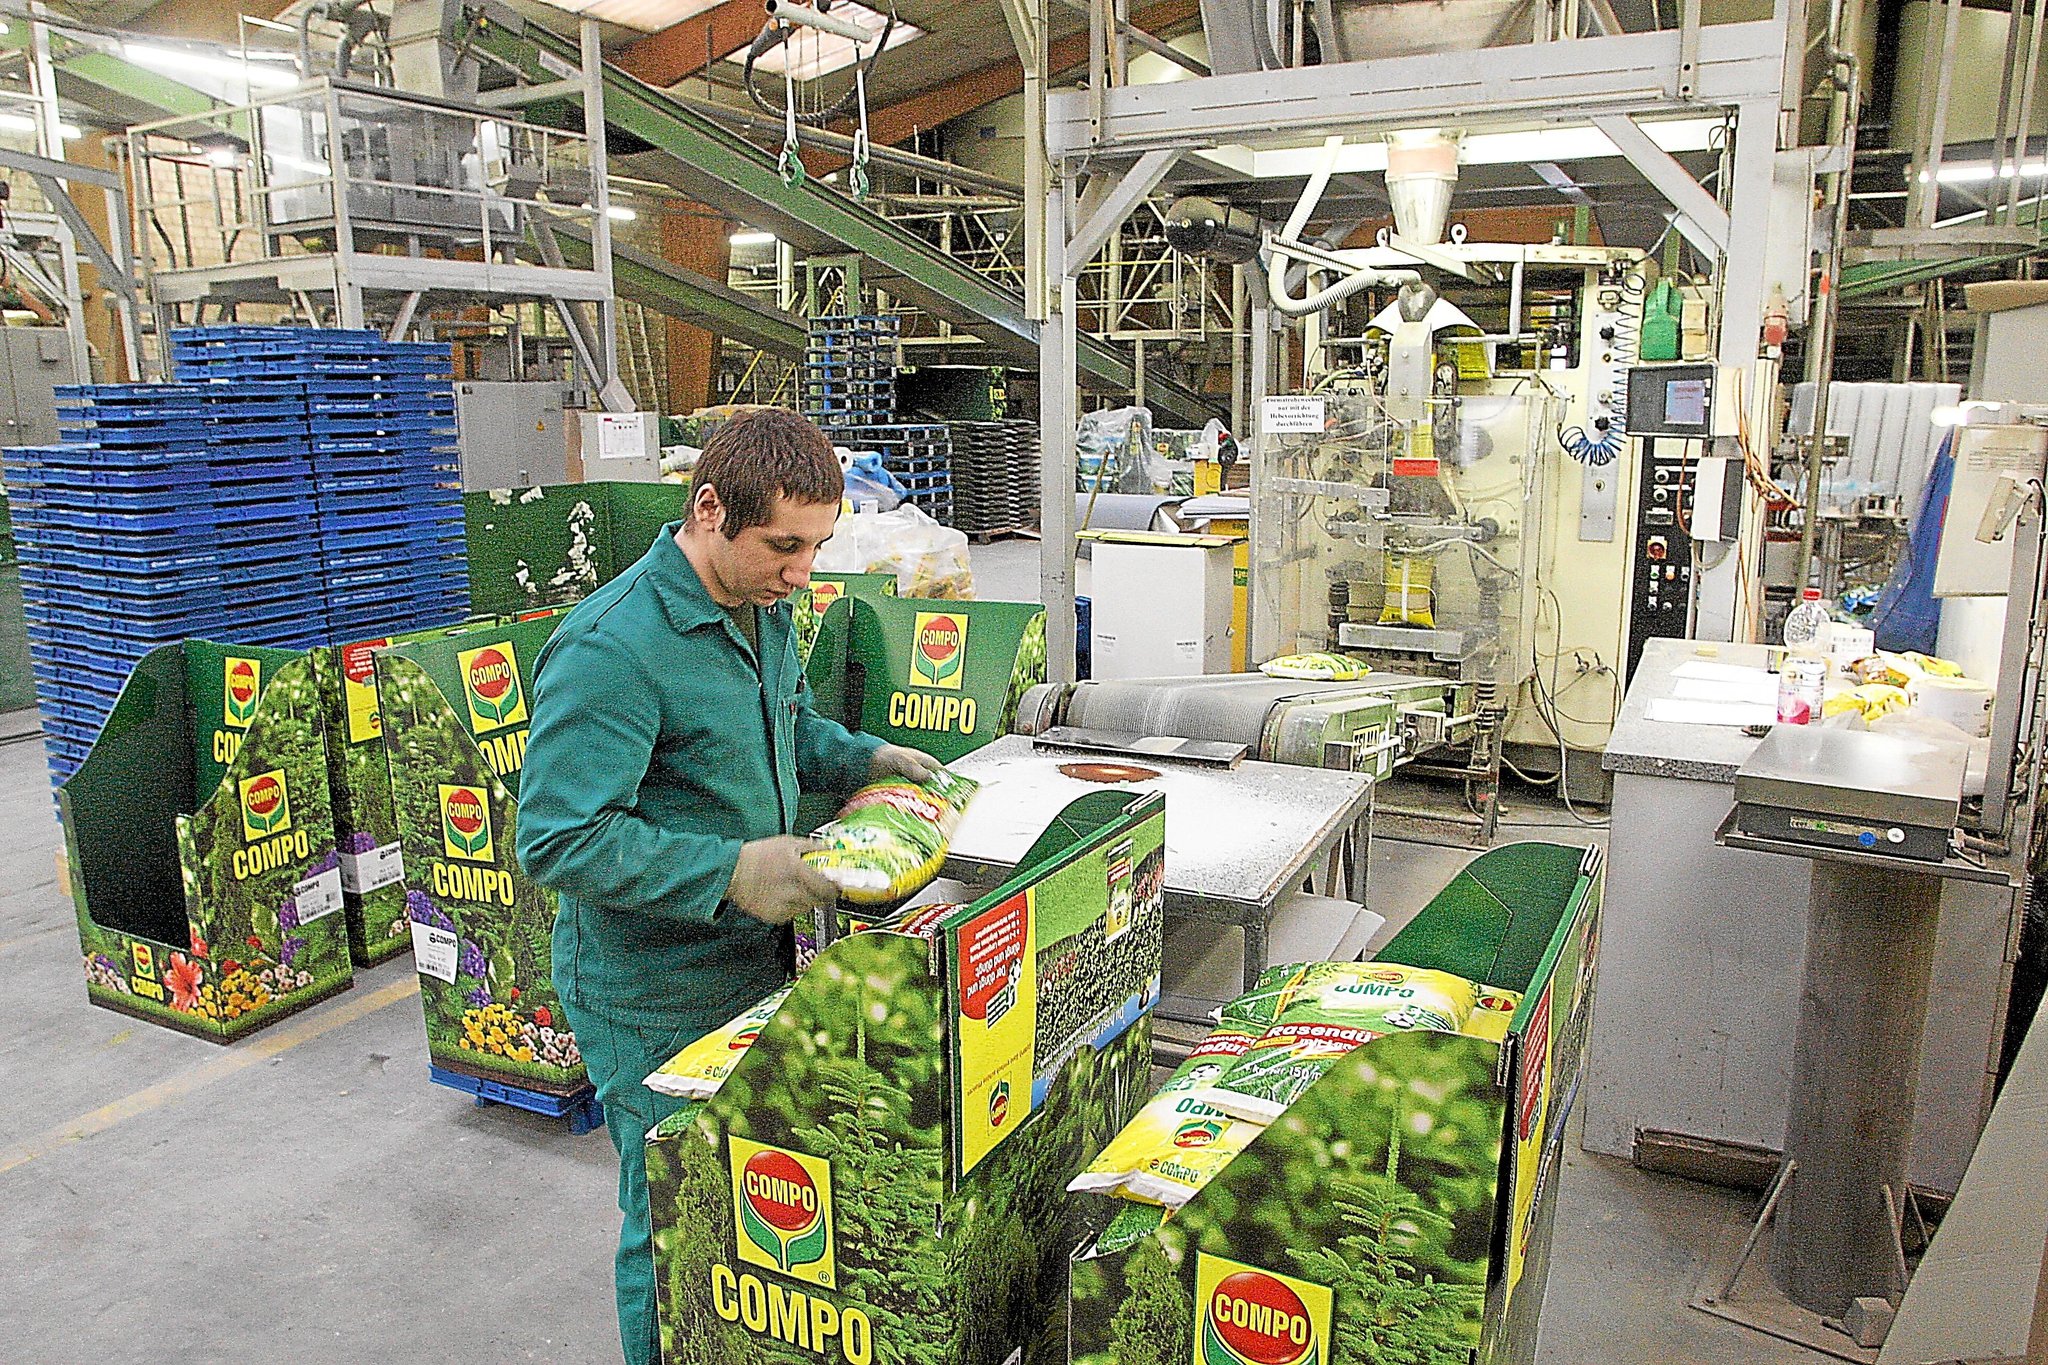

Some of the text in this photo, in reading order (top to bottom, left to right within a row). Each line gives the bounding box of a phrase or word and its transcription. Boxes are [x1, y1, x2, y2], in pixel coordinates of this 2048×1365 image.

[921, 629, 958, 647] COMPO
[471, 661, 510, 686] COMPO
[889, 691, 977, 736] COMPO
[248, 785, 280, 806] COMPO
[448, 801, 483, 821] COMPO
[233, 829, 310, 881] COMPO
[433, 862, 515, 907] COMPO
[745, 1170, 816, 1213] COMPO
[1159, 1160, 1200, 1184] COMPO
[711, 1263, 872, 1365] COMPO
[1214, 1293, 1307, 1345] COMPO
